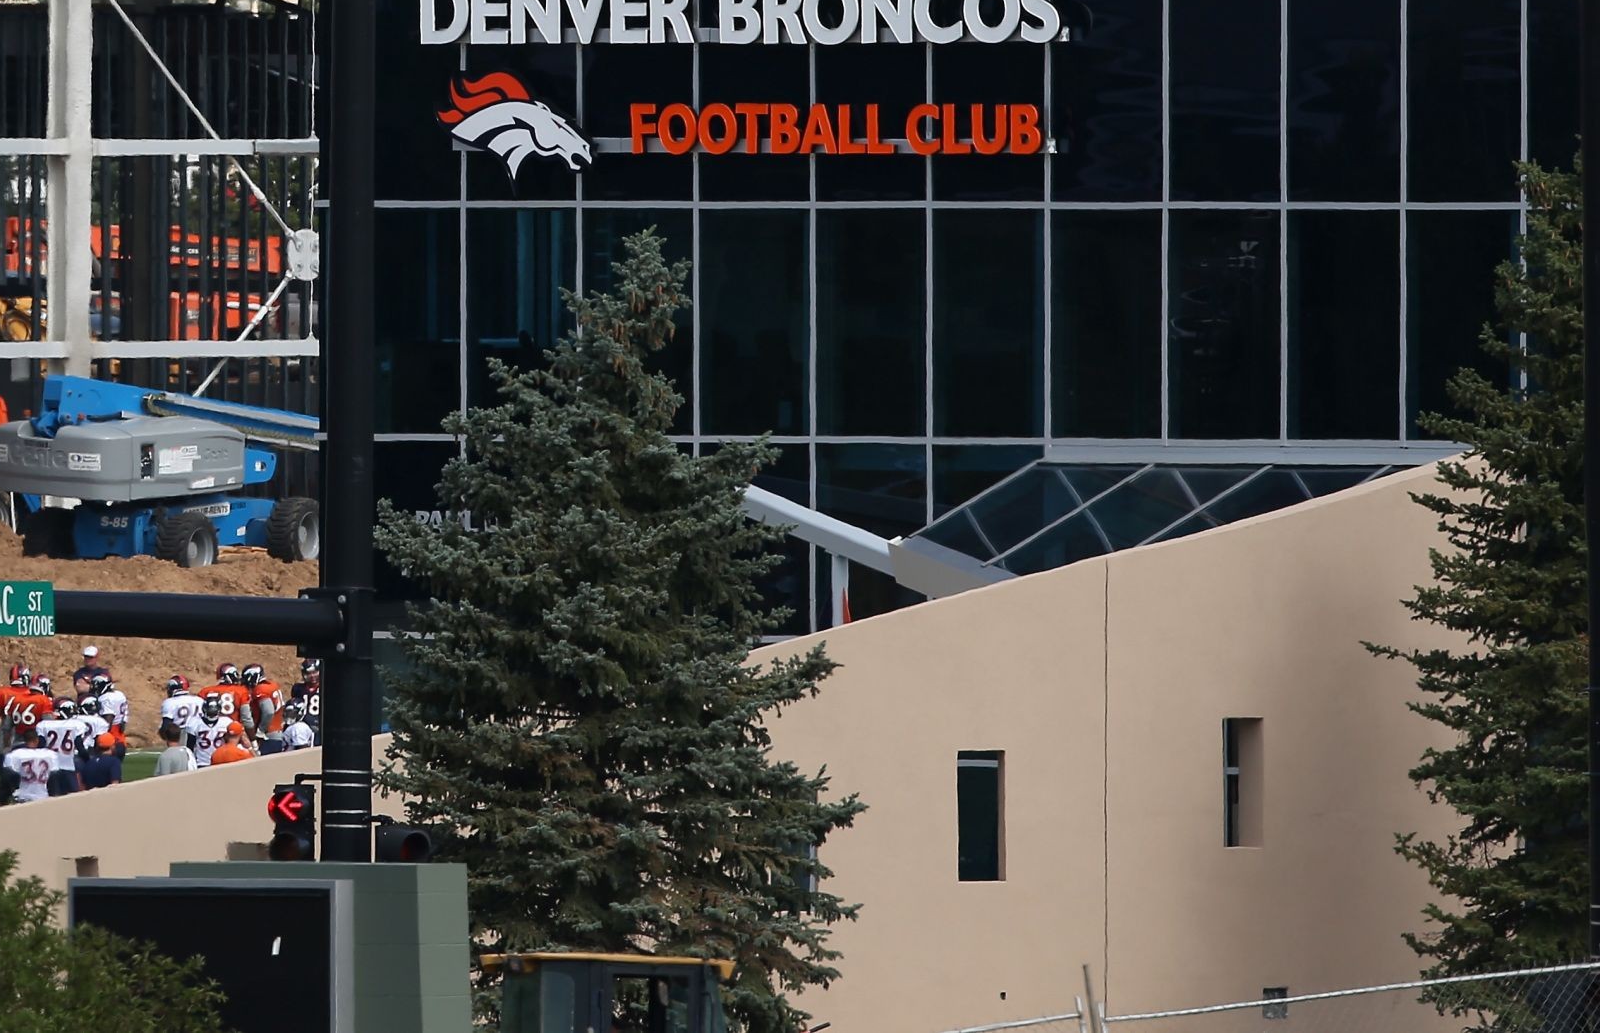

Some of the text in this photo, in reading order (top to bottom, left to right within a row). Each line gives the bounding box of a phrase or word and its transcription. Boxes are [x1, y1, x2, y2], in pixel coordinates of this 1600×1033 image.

[630, 102, 1043, 156] FOOTBALL CLUB
[101, 516, 128, 528] S-85
[28, 591, 43, 612] ST
[17, 615, 55, 636] 13700E
[12, 703, 36, 725] 66
[47, 730, 73, 752] 26
[20, 759, 50, 784] 32
